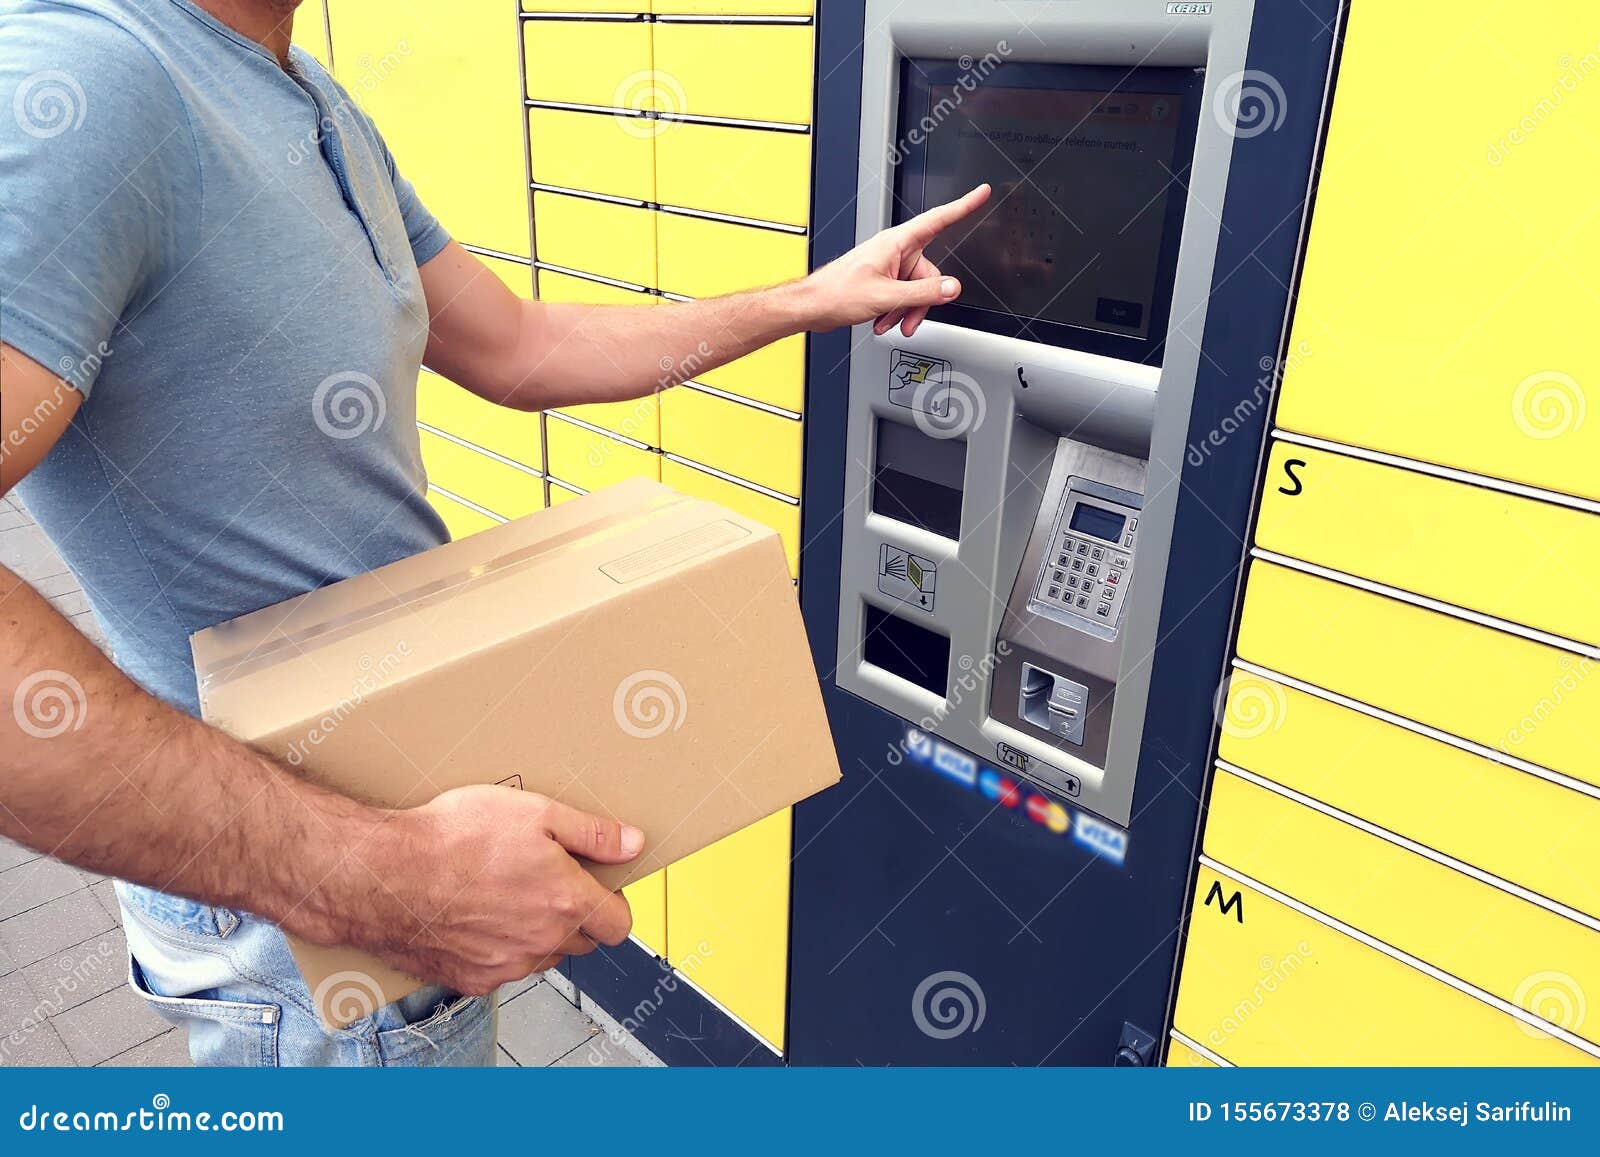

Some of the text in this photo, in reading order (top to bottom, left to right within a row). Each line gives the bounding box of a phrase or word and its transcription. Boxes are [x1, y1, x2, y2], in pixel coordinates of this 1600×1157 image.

[1170, 4, 1207, 13] KEBA
[1278, 459, 1306, 496] S
[1203, 880, 1244, 924] M
